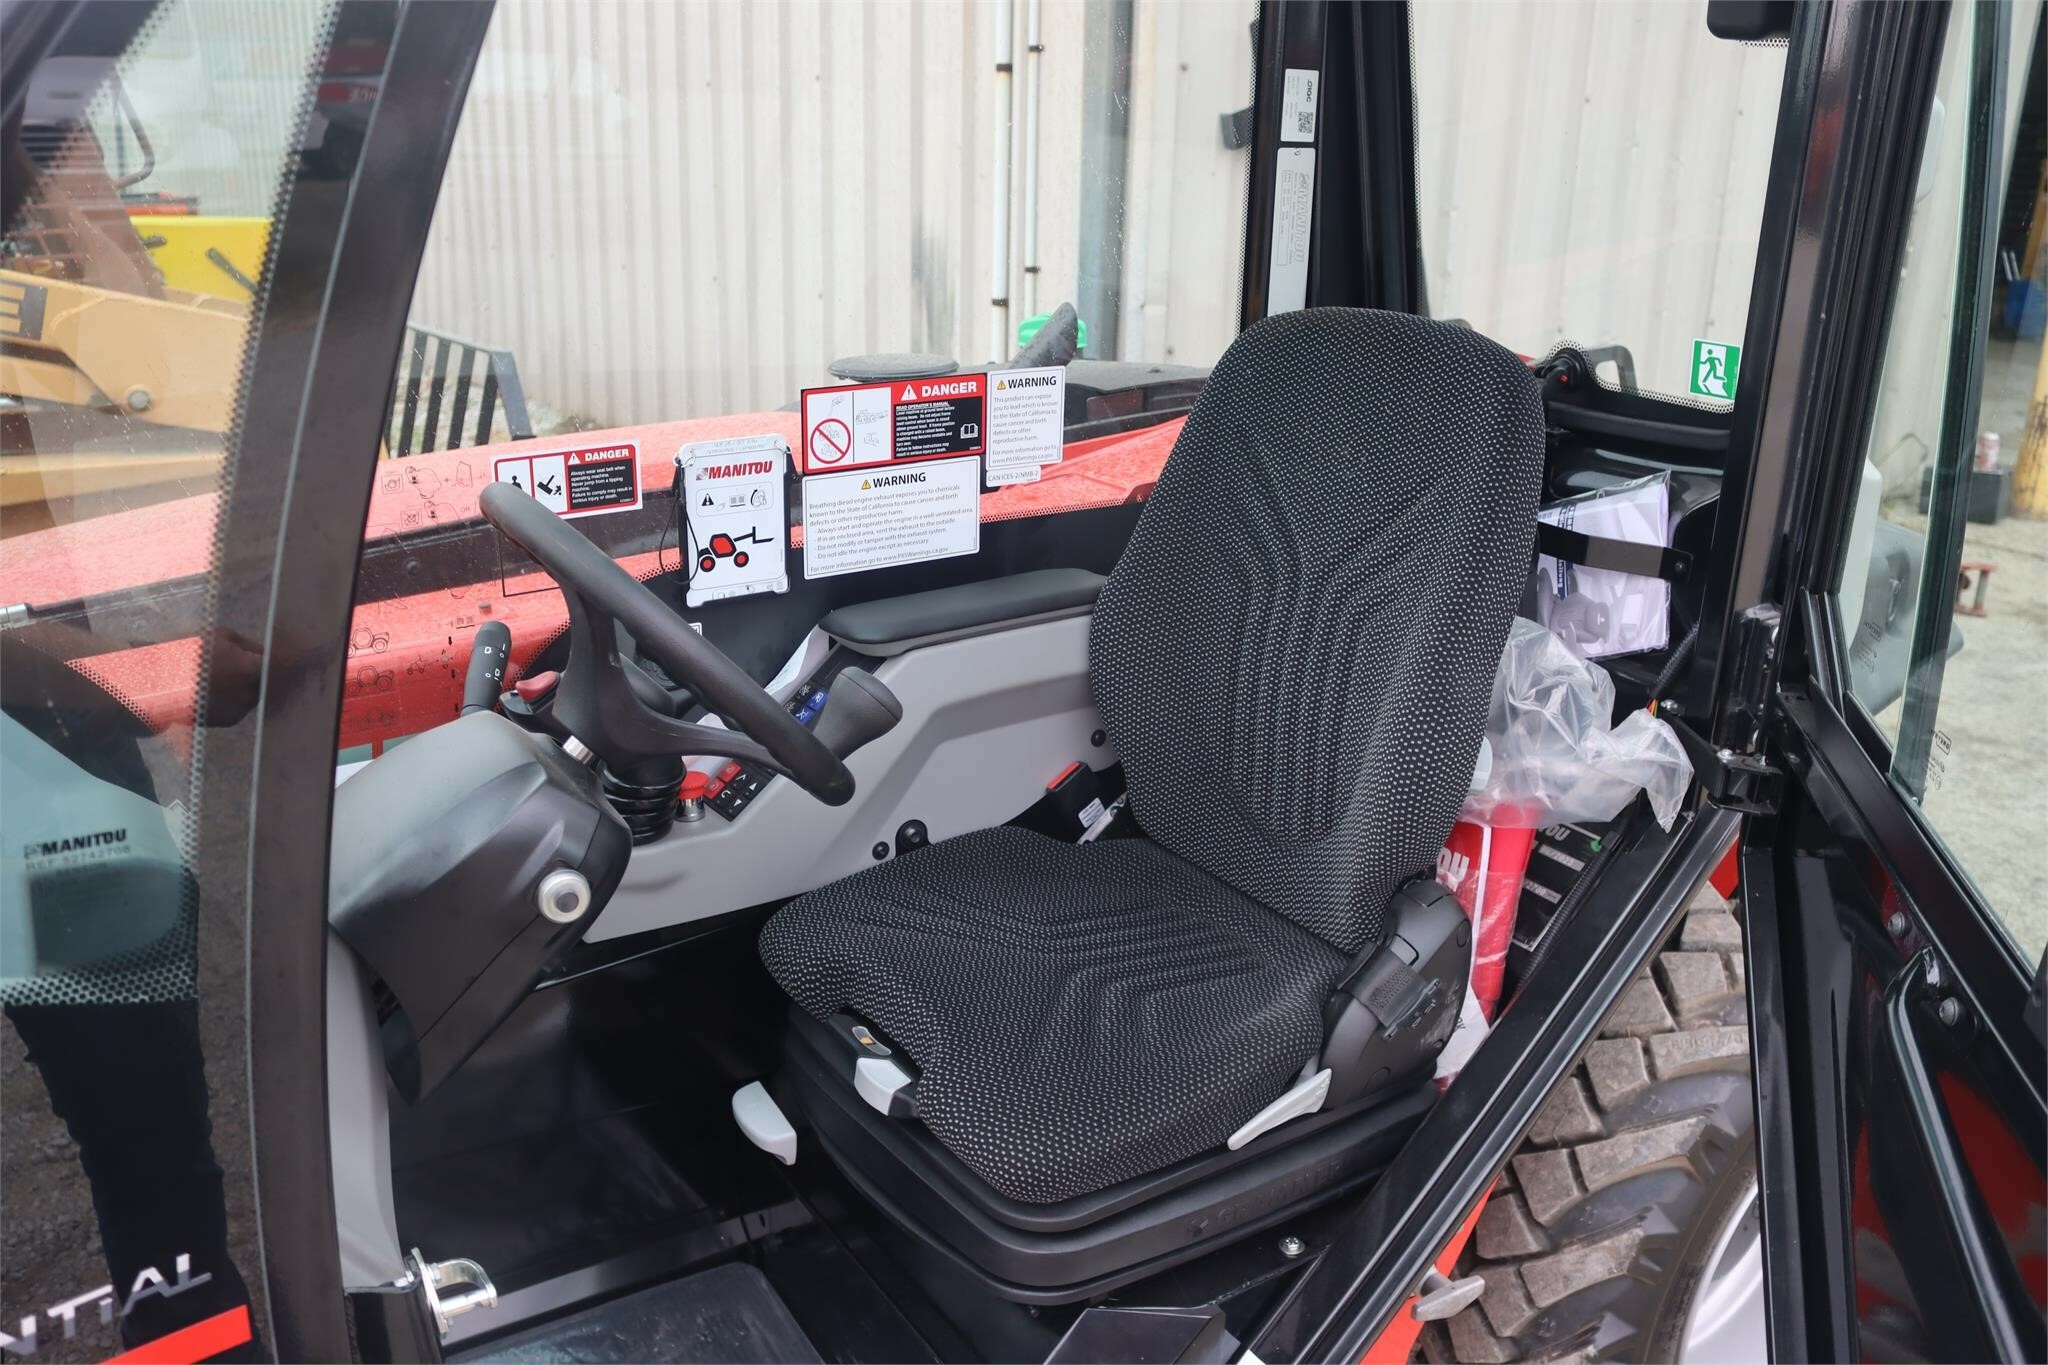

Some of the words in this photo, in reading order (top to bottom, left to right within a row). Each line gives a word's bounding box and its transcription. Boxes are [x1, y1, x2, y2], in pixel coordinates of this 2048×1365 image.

[922, 381, 977, 397] DANGER
[1008, 376, 1057, 389] WARNING
[1005, 395, 1024, 403] product
[585, 449, 629, 461] DANGER
[708, 461, 773, 479] MANITOU
[873, 472, 926, 488] WARNING
[809, 501, 836, 510] Breathing
[854, 496, 872, 504] engine
[874, 493, 894, 501] exhaust
[935, 485, 959, 493] chemicals
[809, 510, 828, 518] known
[868, 502, 893, 510] California
[854, 511, 887, 521] reproductive
[818, 526, 836, 535] Always
[863, 520, 882, 528] operate
[894, 516, 912, 524] engine
[837, 531, 861, 540] enclosed
[899, 523, 918, 531] exhaust
[838, 540, 856, 549] modify
[865, 536, 883, 545] tamper
[859, 545, 877, 554] engine
[878, 542, 896, 551] except
[836, 558, 867, 568] information
[42, 828, 126, 856] MANITOU
